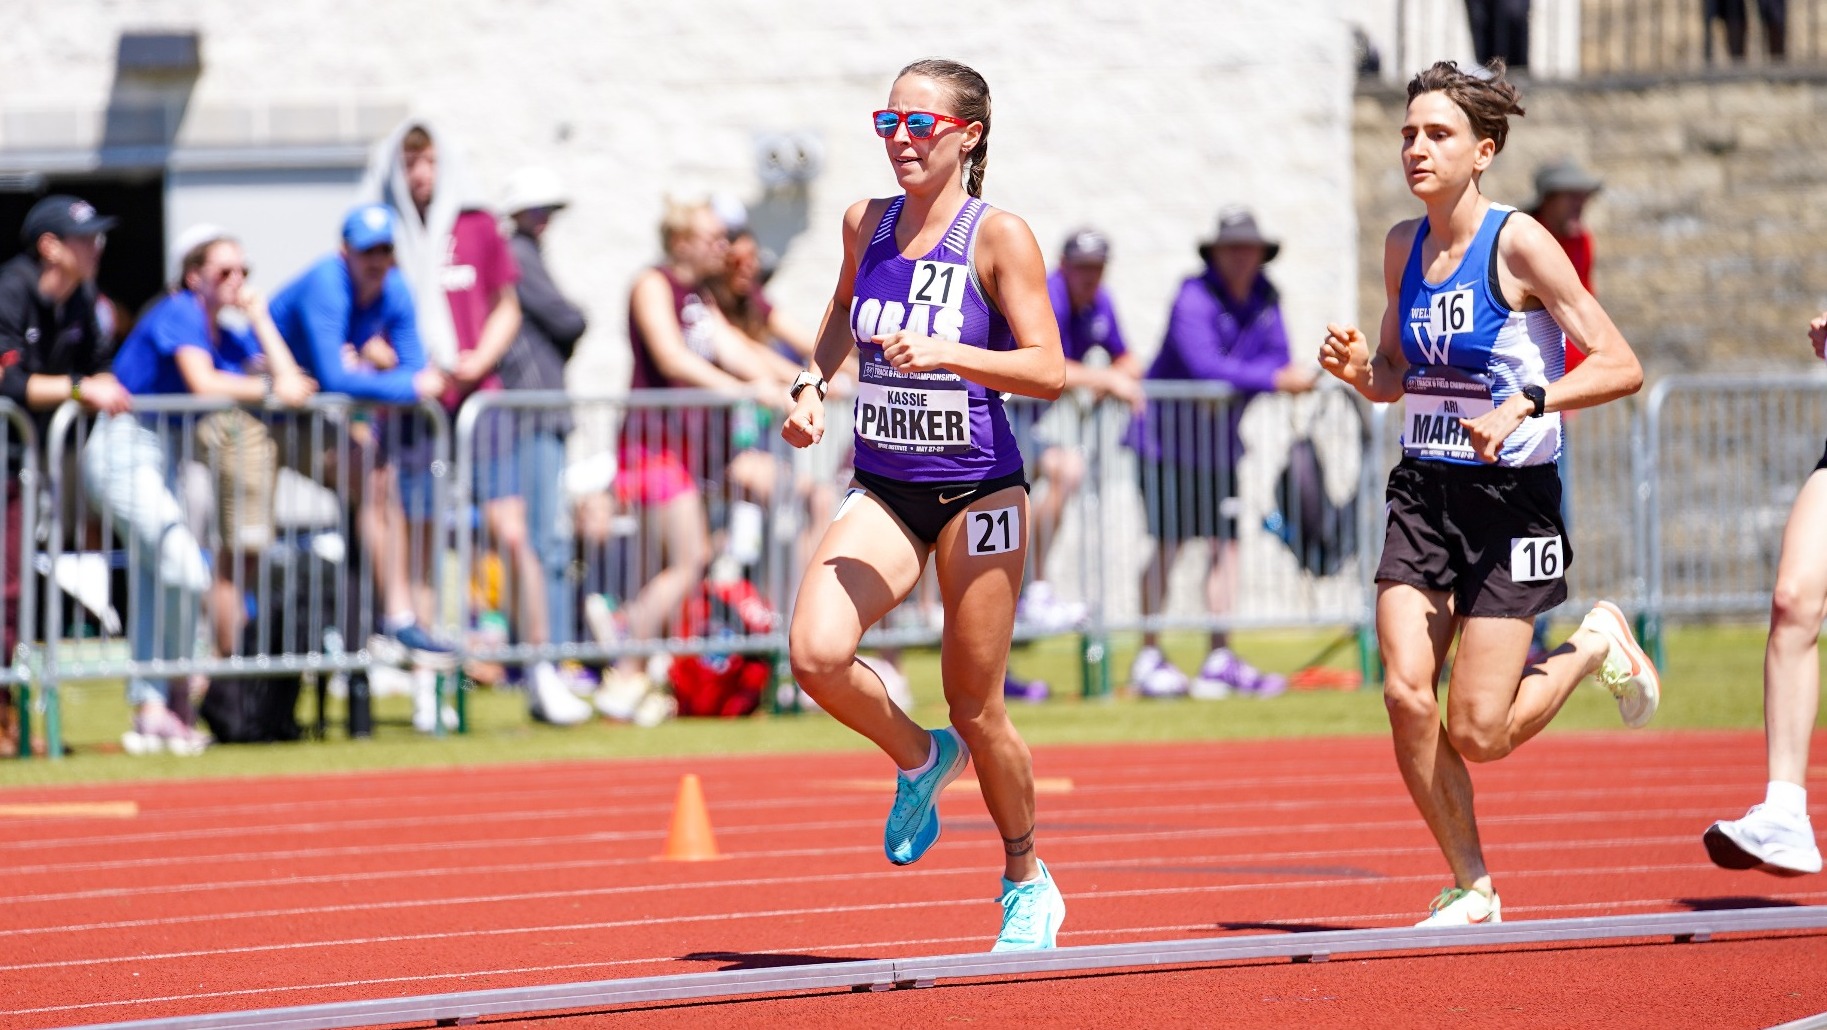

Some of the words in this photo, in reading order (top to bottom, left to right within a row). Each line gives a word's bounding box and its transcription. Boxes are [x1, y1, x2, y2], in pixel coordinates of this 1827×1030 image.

[915, 263, 955, 304] 21
[1437, 293, 1465, 333] 16
[887, 390, 928, 407] KASSIE
[1443, 400, 1459, 414] ARI
[861, 403, 965, 441] PARKER
[975, 510, 1010, 553] 21
[1522, 540, 1557, 577] 16
